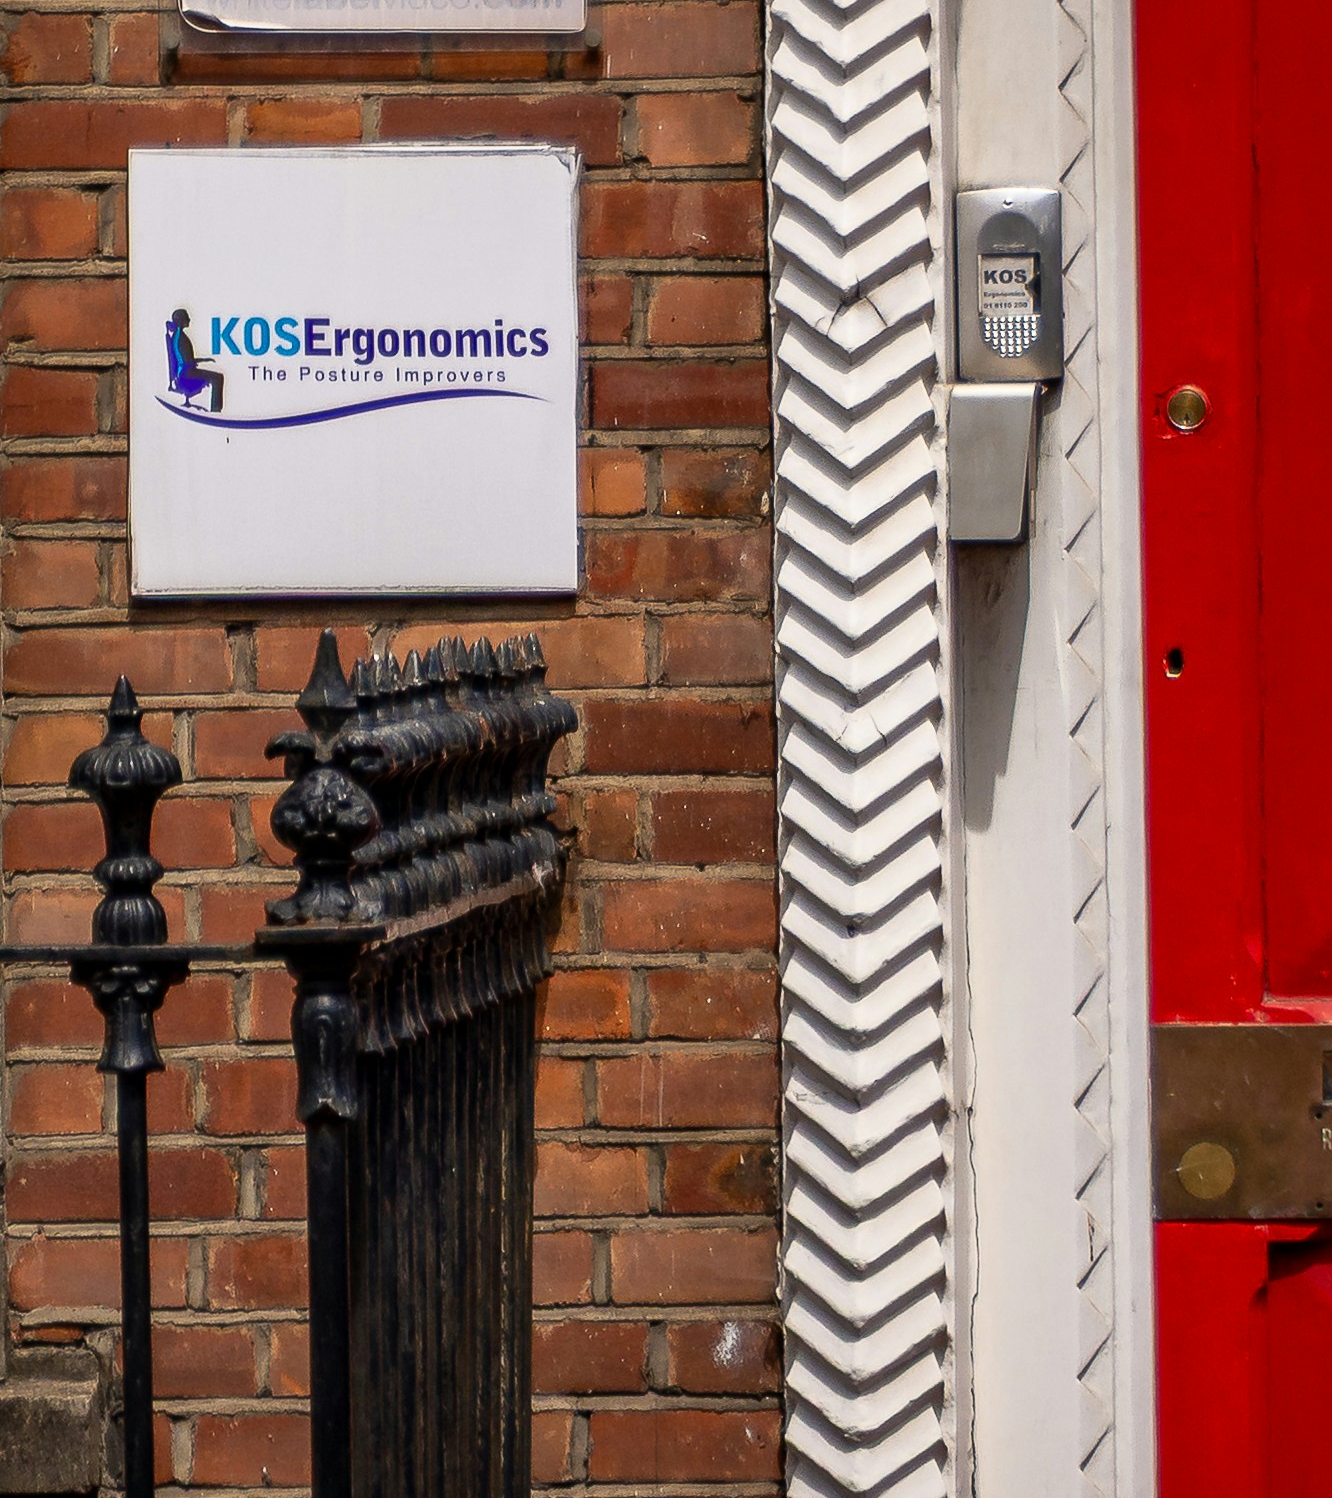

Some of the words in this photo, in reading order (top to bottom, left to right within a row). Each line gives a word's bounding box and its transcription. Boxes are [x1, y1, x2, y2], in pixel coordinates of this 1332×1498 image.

[983, 268, 1028, 285] KOS
[248, 365, 288, 383] The
[299, 365, 384, 383] Posture
[395, 365, 508, 386] Improvers
